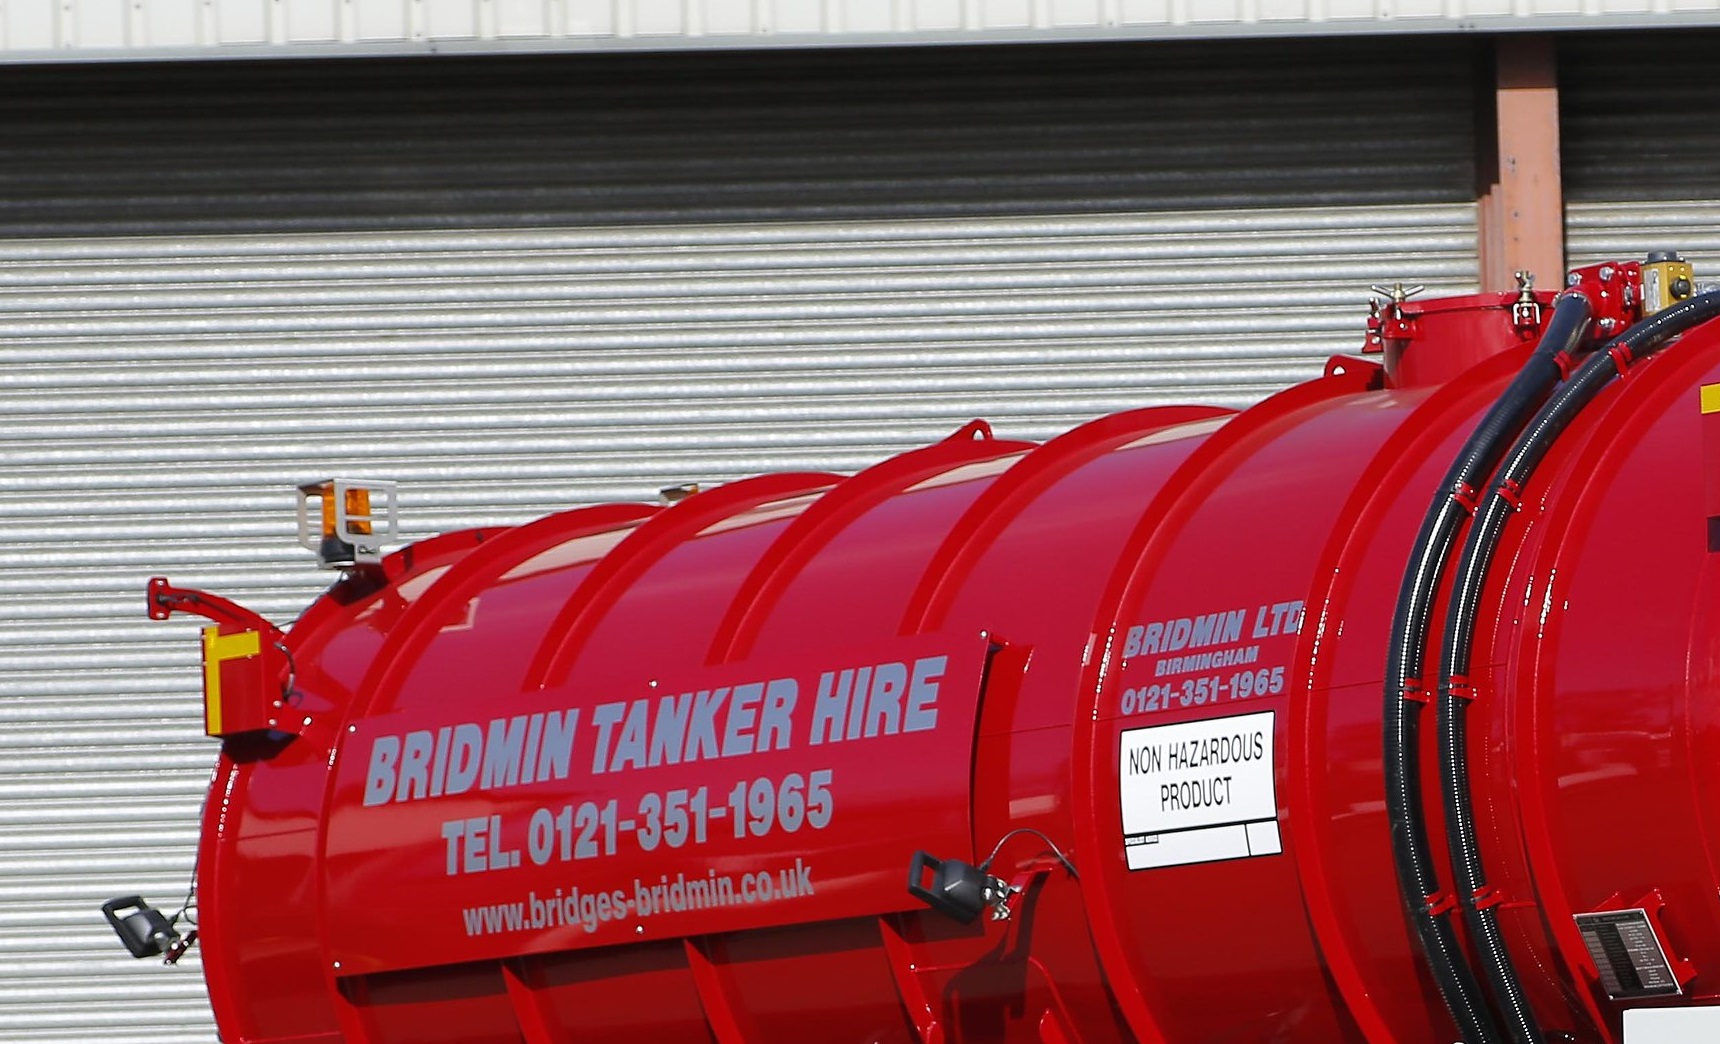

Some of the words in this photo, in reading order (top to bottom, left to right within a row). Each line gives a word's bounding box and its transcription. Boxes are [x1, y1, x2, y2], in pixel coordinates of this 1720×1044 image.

[1121, 609, 1246, 658] BRIDMIN
[1252, 600, 1304, 639] LTD
[1155, 645, 1259, 677] BIRMINGHAM
[1121, 666, 1285, 715] 0121-351-1965
[362, 707, 579, 807] BRIDMIN
[591, 678, 799, 774] TANKER
[809, 655, 948, 746] HIRE
[1129, 745, 1162, 776] NON
[1168, 731, 1264, 771] HAZARDOUS
[1161, 776, 1232, 812] PRODUCT
[441, 814, 520, 875] TEL.
[527, 770, 834, 866] 0121-351-1965
[463, 858, 814, 936] www.bridges-bridmin.co.uk
